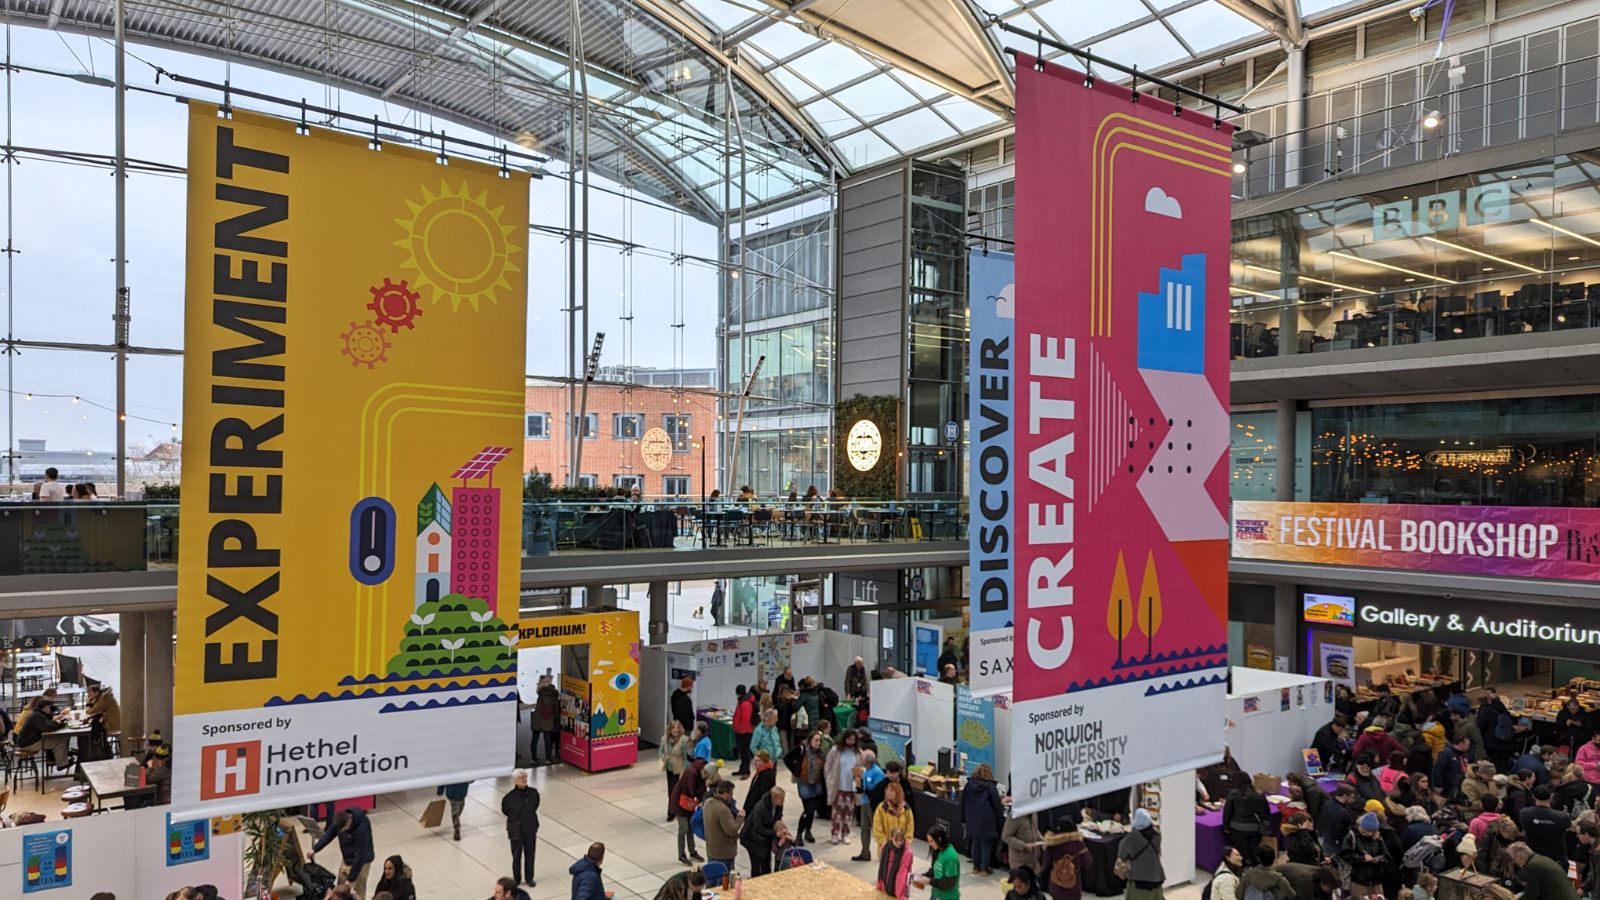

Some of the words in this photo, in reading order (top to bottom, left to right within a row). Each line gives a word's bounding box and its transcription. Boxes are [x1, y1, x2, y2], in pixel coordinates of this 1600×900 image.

[1381, 187, 1504, 234] BBC
[203, 126, 290, 684] EXPERIMENT
[979, 335, 1010, 613] DISCOVER
[1027, 333, 1075, 670] CREATE
[1279, 515, 1393, 551] FESTIVAL
[1400, 519, 1559, 559] BOOKSHOP
[853, 579, 879, 602] Lift
[518, 624, 586, 640] XPLORIUM!
[1360, 604, 1440, 632] Gallery
[1447, 613, 1464, 631] &
[25, 637, 34, 647] &
[47, 636, 82, 646] BAR
[980, 635, 1008, 647] Sponsored
[202, 719, 273, 737] Sponsored
[276, 716, 292, 731] by
[1029, 705, 1072, 725] Sponsored
[1074, 704, 1085, 717] by
[267, 735, 359, 764] Hethel
[1035, 720, 1103, 754] NORWICH
[1045, 735, 1128, 773] UNIVERSITY
[266, 752, 409, 786] Innovation
[1030, 776, 1047, 798] OF
[1052, 768, 1081, 791] THE
[1085, 757, 1121, 785] ARTS
